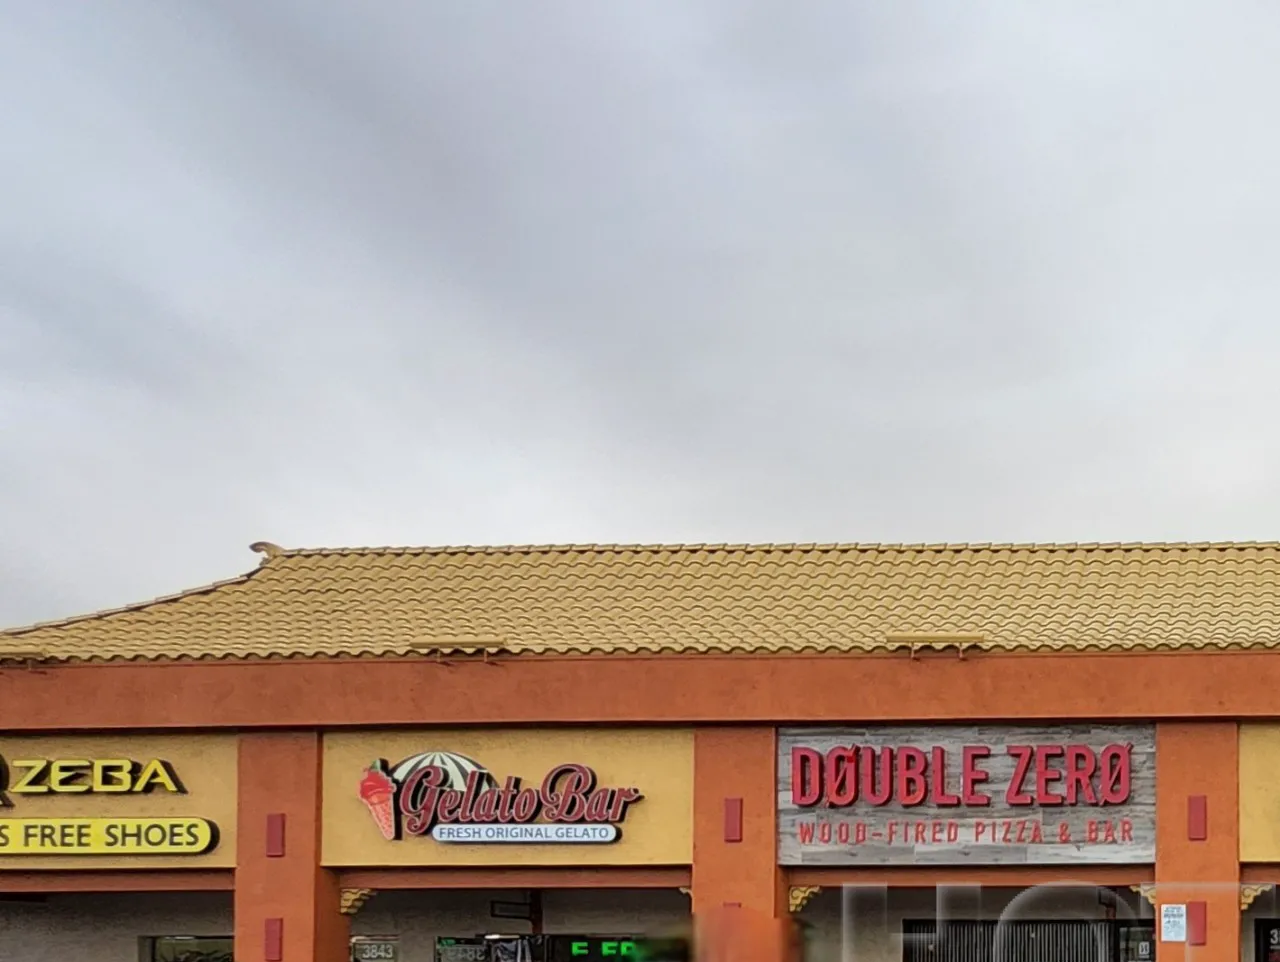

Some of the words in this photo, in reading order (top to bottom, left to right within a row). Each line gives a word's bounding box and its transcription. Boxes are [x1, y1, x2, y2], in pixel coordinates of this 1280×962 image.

[8, 758, 182, 793] ZEBA
[400, 764, 541, 835] Gelato
[540, 763, 641, 824] Bar
[23, 824, 92, 848] FREE
[104, 823, 200, 848] SHOES
[438, 827, 482, 839] FRESH
[485, 827, 551, 839] ORIGINAL
[555, 827, 610, 839] GELATO
[799, 819, 959, 845] WOOD-FIRED
[973, 820, 1044, 844] PIZZA
[1058, 819, 1072, 843] &
[1087, 819, 1134, 843] BAR
[361, 944, 394, 959] 3843
